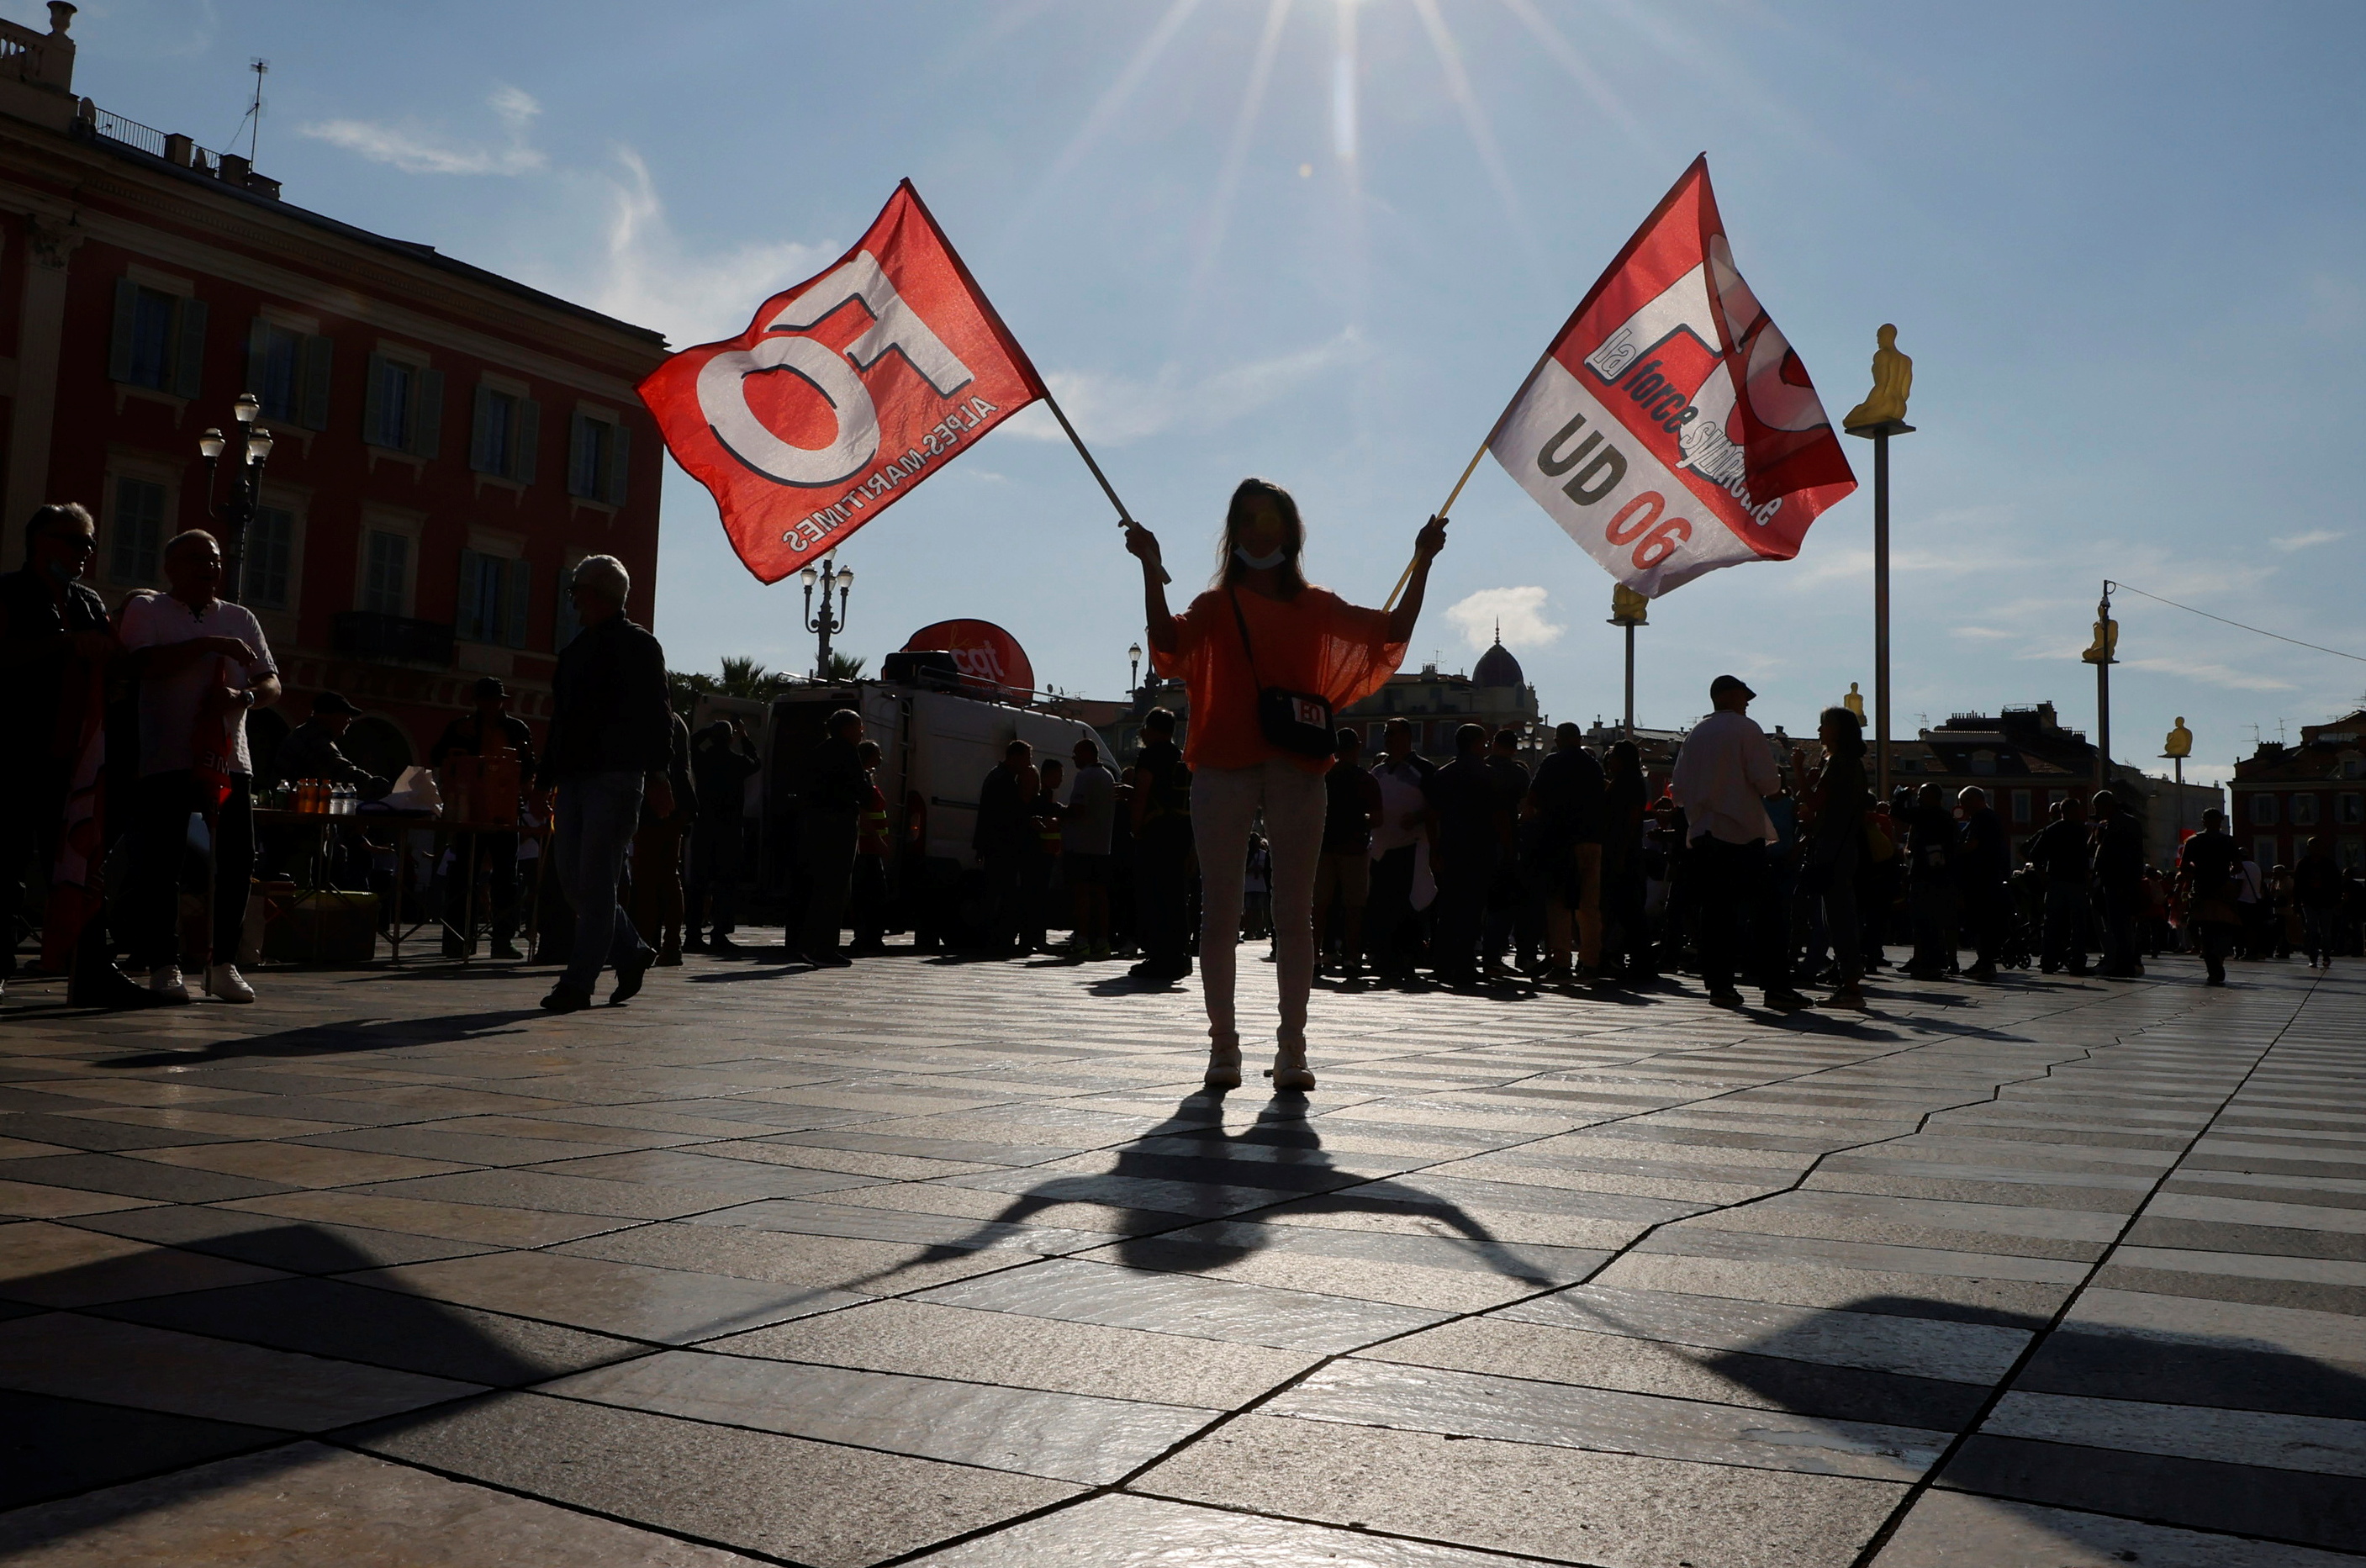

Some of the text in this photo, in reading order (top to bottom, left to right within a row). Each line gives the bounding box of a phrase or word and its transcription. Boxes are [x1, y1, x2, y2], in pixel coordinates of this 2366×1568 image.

[1592, 328, 1637, 377] la
[1624, 359, 1699, 434] force
[1536, 413, 1693, 571] UD 06
[949, 640, 1006, 684] cgt
